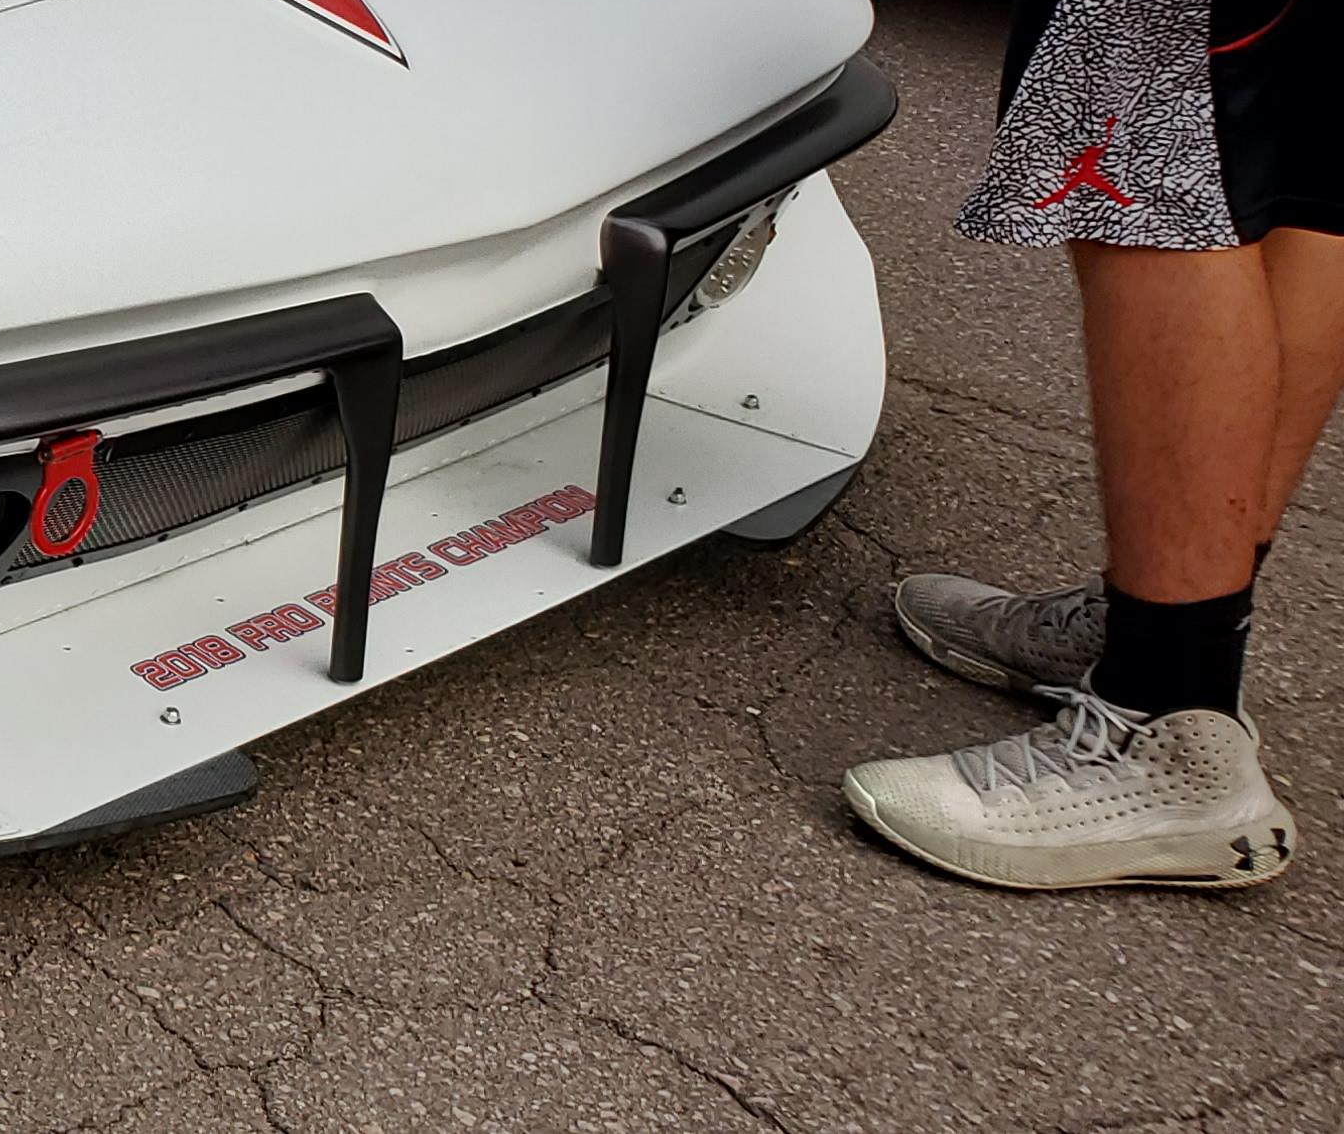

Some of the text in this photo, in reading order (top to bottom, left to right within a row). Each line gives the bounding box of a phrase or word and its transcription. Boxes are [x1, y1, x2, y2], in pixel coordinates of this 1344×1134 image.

[130, 485, 597, 691] 2018 PRO PINTS CHAMPION
